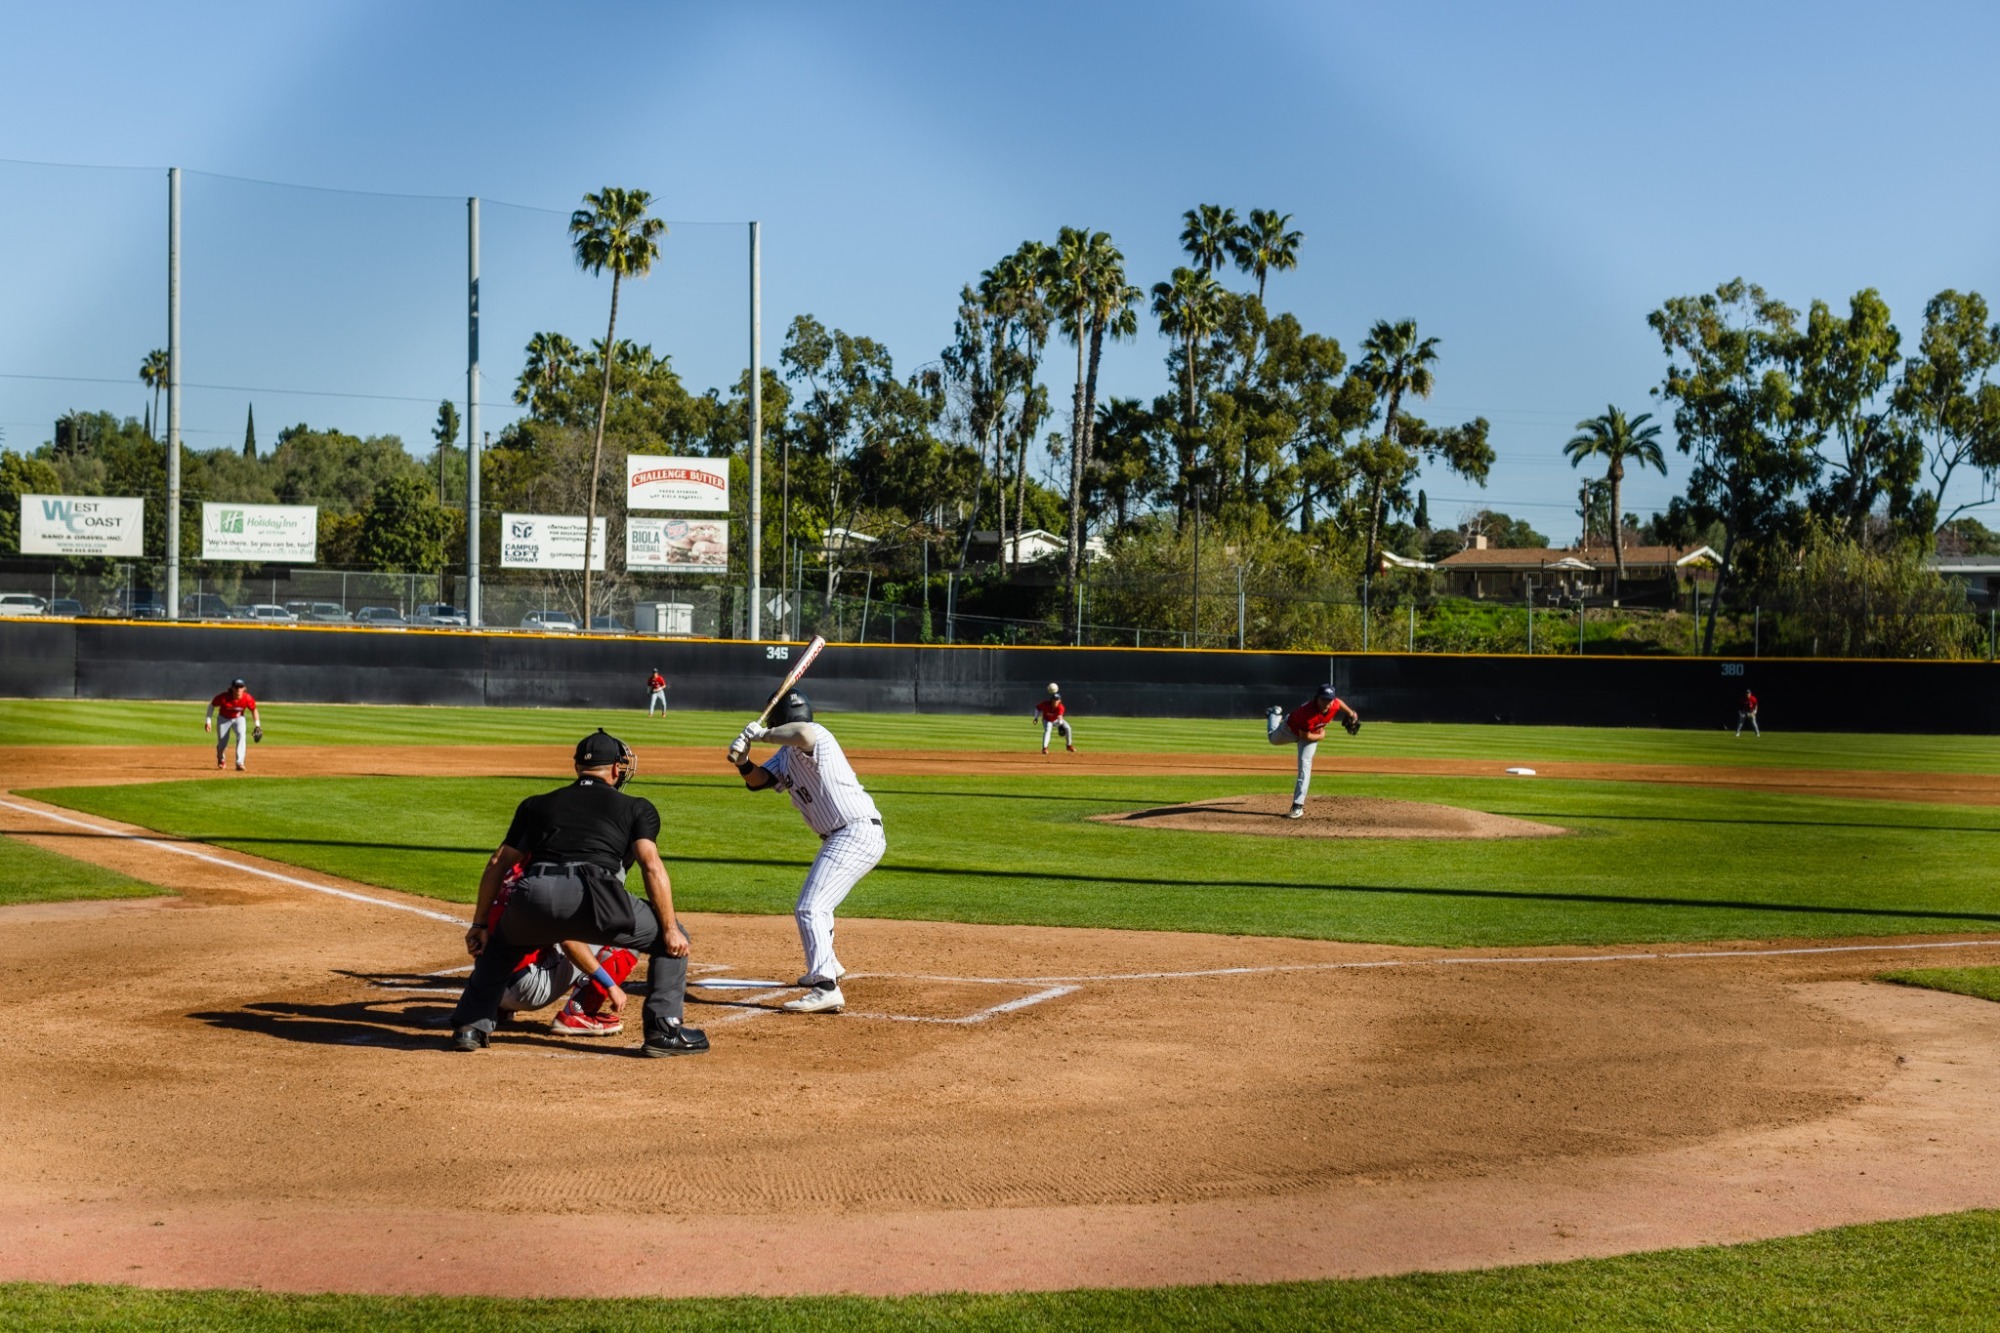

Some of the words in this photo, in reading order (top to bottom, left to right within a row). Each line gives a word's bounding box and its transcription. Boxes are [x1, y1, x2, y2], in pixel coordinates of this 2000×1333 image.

[633, 470, 687, 485] CHALLENGE
[690, 471, 724, 488] BUTTER
[246, 517, 282, 528] Holiday
[283, 518, 298, 528] Inn
[632, 530, 660, 544] BIOLA
[632, 544, 660, 552] BASEBALL
[766, 646, 789, 660] 345
[1721, 663, 1744, 676] 380
[796, 786, 812, 804] 18
